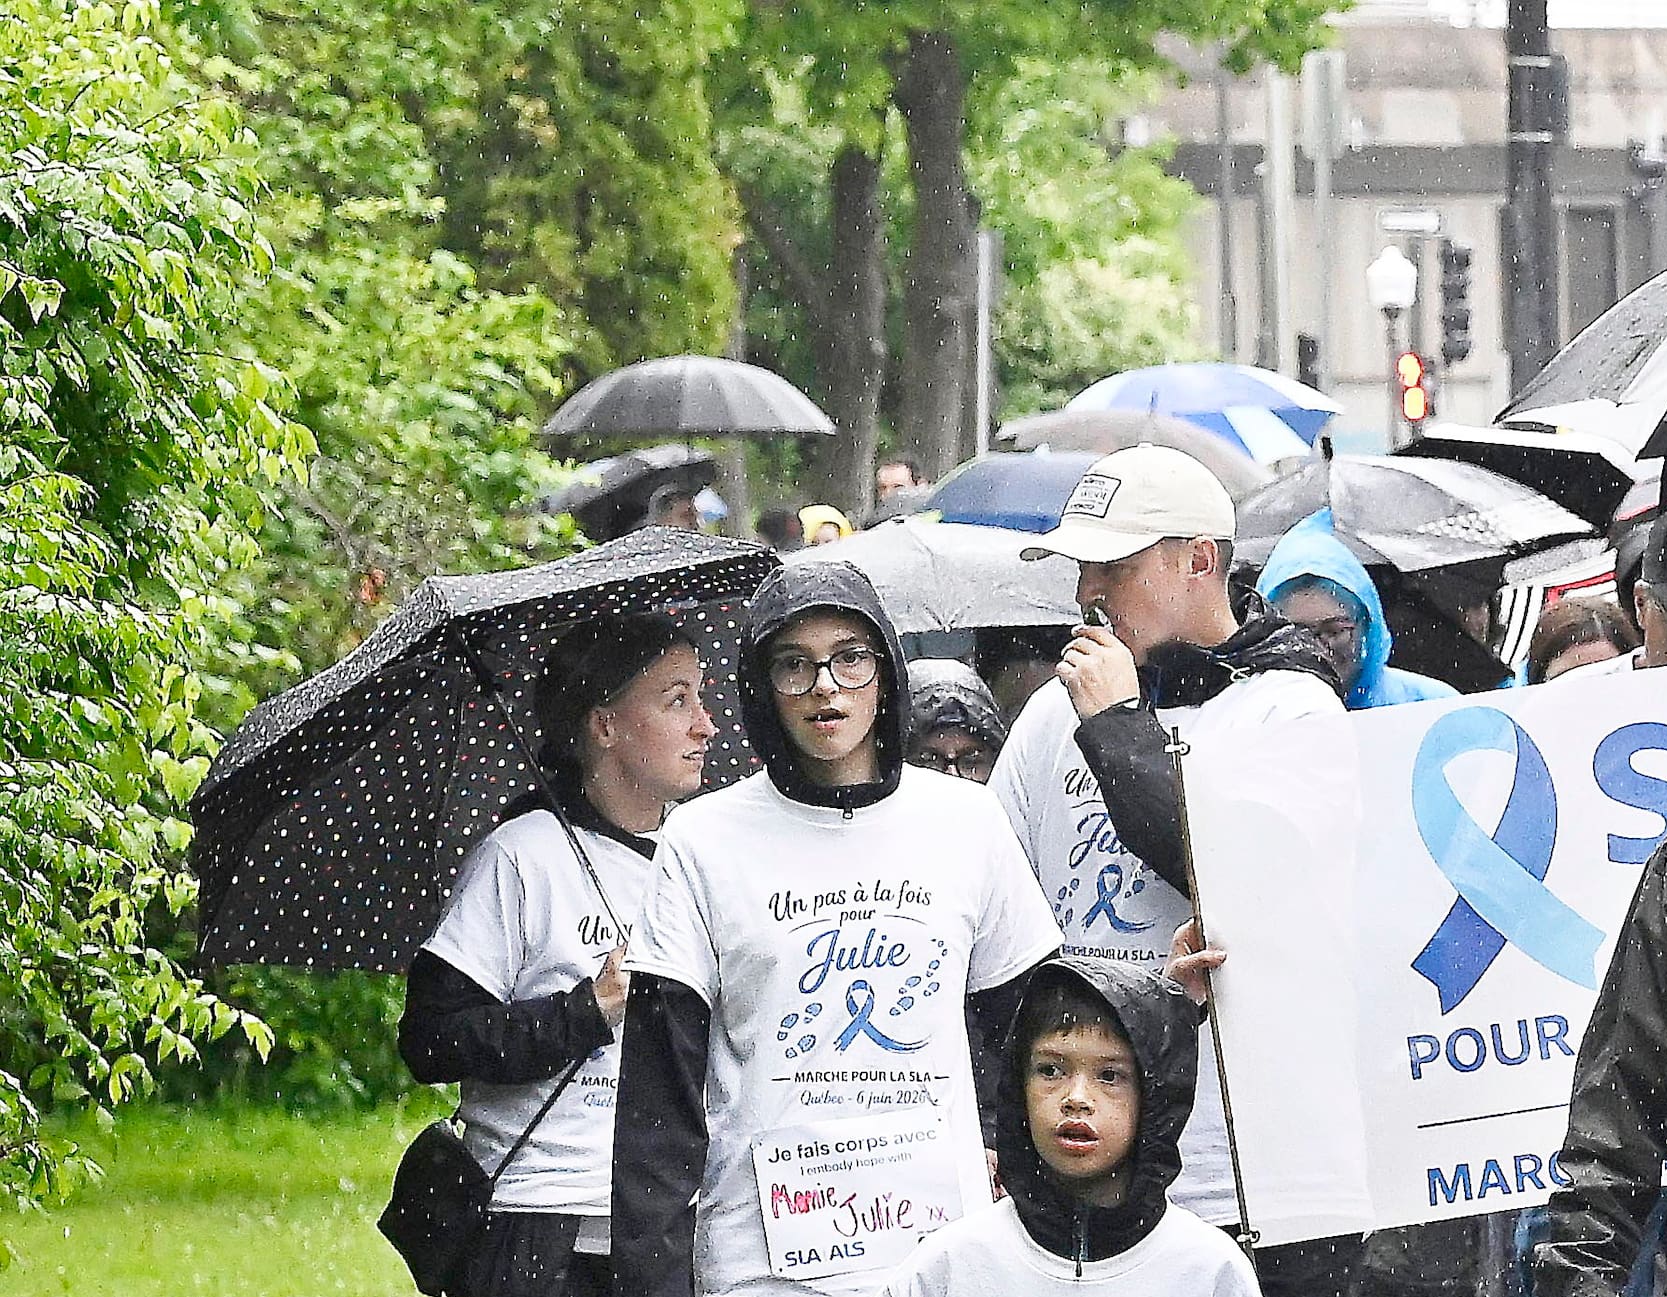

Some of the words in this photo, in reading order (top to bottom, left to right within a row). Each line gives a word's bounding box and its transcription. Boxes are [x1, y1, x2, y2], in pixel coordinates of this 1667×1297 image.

[768, 890, 807, 922] Un
[813, 889, 847, 917] pas
[853, 881, 868, 903] à
[873, 879, 894, 902] la
[896, 880, 932, 909] fois
[578, 914, 613, 945] Un
[839, 909, 876, 927] pour
[798, 928, 911, 994] Julie
[1407, 1014, 1576, 1080] POUR
[580, 1076, 617, 1090] MARC
[794, 1071, 848, 1083] MARCHE
[851, 1071, 887, 1083] POUR
[890, 1071, 906, 1082] LA
[908, 1071, 932, 1082] SLA
[768, 1147, 792, 1163] Je
[797, 1141, 830, 1159] fais
[834, 1137, 889, 1152] corps
[893, 1128, 938, 1145] avec
[806, 1158, 853, 1175] embody
[855, 1155, 886, 1168] hope
[887, 1152, 912, 1163] with
[1427, 1150, 1572, 1207] MARC
[833, 1191, 914, 1237] Julie
[785, 1249, 822, 1267] SLA
[829, 1241, 865, 1261] ALS
